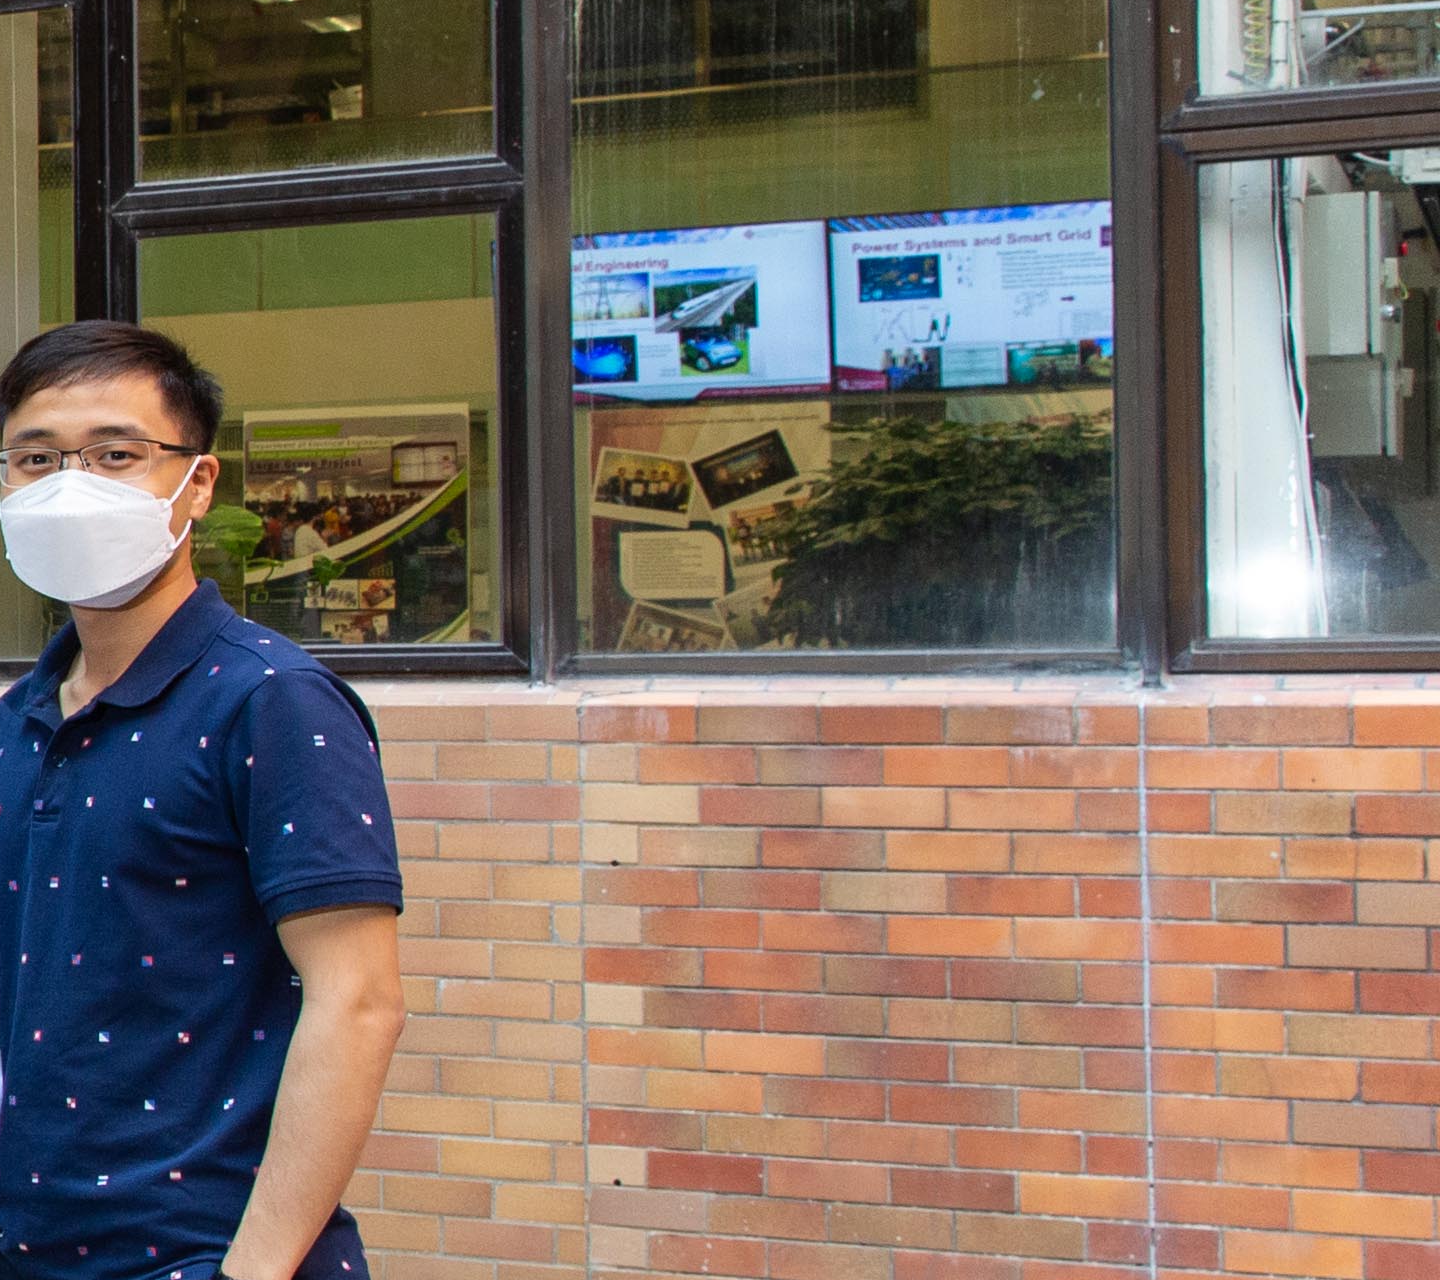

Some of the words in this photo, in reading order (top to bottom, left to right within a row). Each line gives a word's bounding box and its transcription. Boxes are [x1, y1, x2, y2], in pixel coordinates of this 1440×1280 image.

[851, 241, 899, 254] Power
[904, 237, 968, 253] Systems
[973, 233, 1002, 247] and
[1007, 231, 1052, 245] Smart
[1057, 228, 1092, 241] Grid
[585, 259, 669, 274] Engineering
